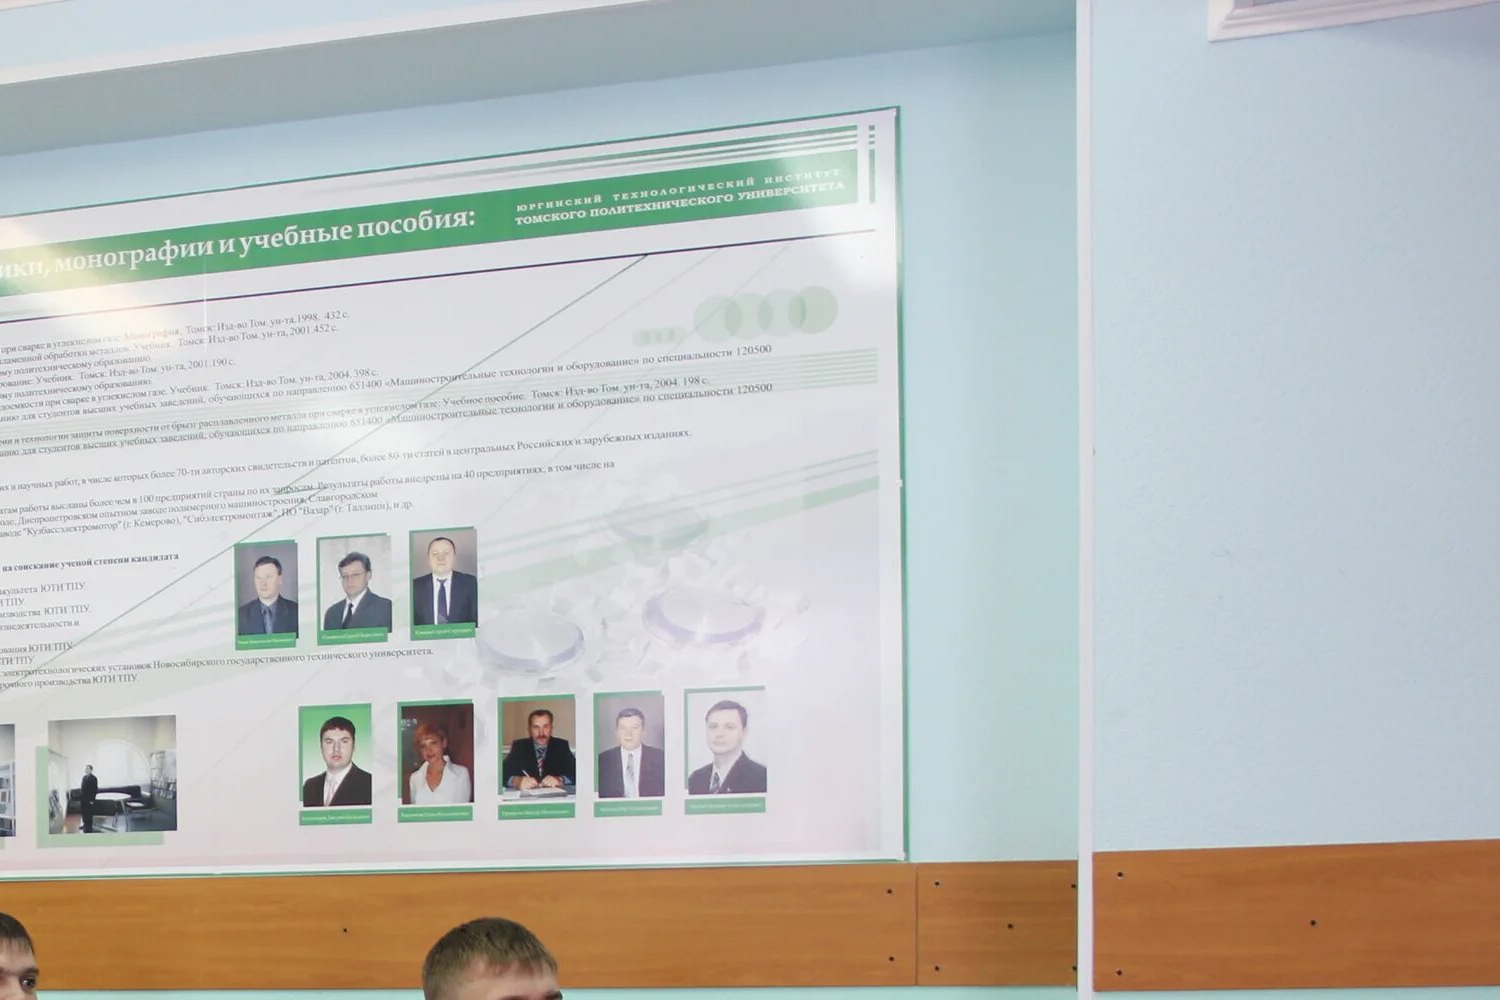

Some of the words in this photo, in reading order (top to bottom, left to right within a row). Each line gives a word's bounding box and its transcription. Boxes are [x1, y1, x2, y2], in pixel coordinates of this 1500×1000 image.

[516, 193, 602, 212] ЮРГИНСКИЙ
[612, 175, 754, 201] ТЕХНОЛОГИЧЕСКИЙ
[765, 166, 841, 183] ИНСТИТУТ
[515, 209, 586, 225] ТОМСКОГО
[590, 192, 734, 217] ПОЛИТЕХНИЧЕСКОГО
[737, 179, 844, 200] УНИВЕРСИТЕТА
[52, 239, 213, 274] монографии
[218, 238, 233, 255] и
[239, 224, 351, 257] учебные
[357, 208, 475, 239] пособия:
[1, 345, 16, 355] при
[18, 342, 44, 352] сварке
[324, 309, 340, 319] 432
[14, 361, 92, 375] политехническому
[44, 350, 87, 361] обработки
[21, 413, 35, 421] для
[38, 409, 80, 420] студентов
[82, 405, 116, 414] высших
[120, 401, 156, 413] учебных
[286, 384, 346, 397] направлению
[349, 378, 382, 389] 651400
[500, 365, 553, 376] технологии
[657, 349, 732, 362] специальности
[737, 343, 773, 355] 120500
[45, 399, 60, 408] при
[62, 396, 89, 406] сварке
[98, 391, 146, 404] углекислом
[354, 367, 370, 377] 398
[658, 388, 733, 401] специальности
[738, 382, 773, 393] 120500
[21, 433, 69, 443] технологии
[70, 430, 103, 439] защиты
[104, 425, 159, 436] поверхности
[198, 415, 269, 430] расплавленного
[17, 481, 52, 491] научных
[54, 477, 79, 489] работ,
[113, 473, 149, 483] которых
[150, 470, 175, 479] более
[248, 460, 307, 471] свидетельств
[453, 443, 515, 456] центральных
[517, 439, 573, 450] Российских
[19, 504, 49, 515] работы
[89, 499, 113, 507] более
[139, 494, 154, 503] 100
[155, 490, 211, 504] предприятий
[213, 489, 245, 499] страны
[464, 470, 475, 479] 40
[477, 466, 545, 480] предприятиях,
[574, 462, 601, 470] числе
[99, 509, 137, 518] опытном
[140, 507, 166, 515] заводе
[168, 502, 226, 513] полимерного
[14, 562, 59, 571] соискание
[61, 558, 92, 570] ученой
[94, 557, 129, 565] степени
[131, 553, 179, 563] кандидата
[40, 582, 63, 592] ЮТИ
[44, 605, 67, 614] ЮТИ
[28, 643, 52, 652] ЮТИ
[108, 663, 151, 673] установок
[153, 658, 225, 669] Новосибирского
[226, 654, 305, 666] государственного
[307, 651, 367, 660] технического
[369, 648, 434, 660] университета.
[34, 677, 90, 689] производства
[92, 674, 116, 683] ЮТИ
